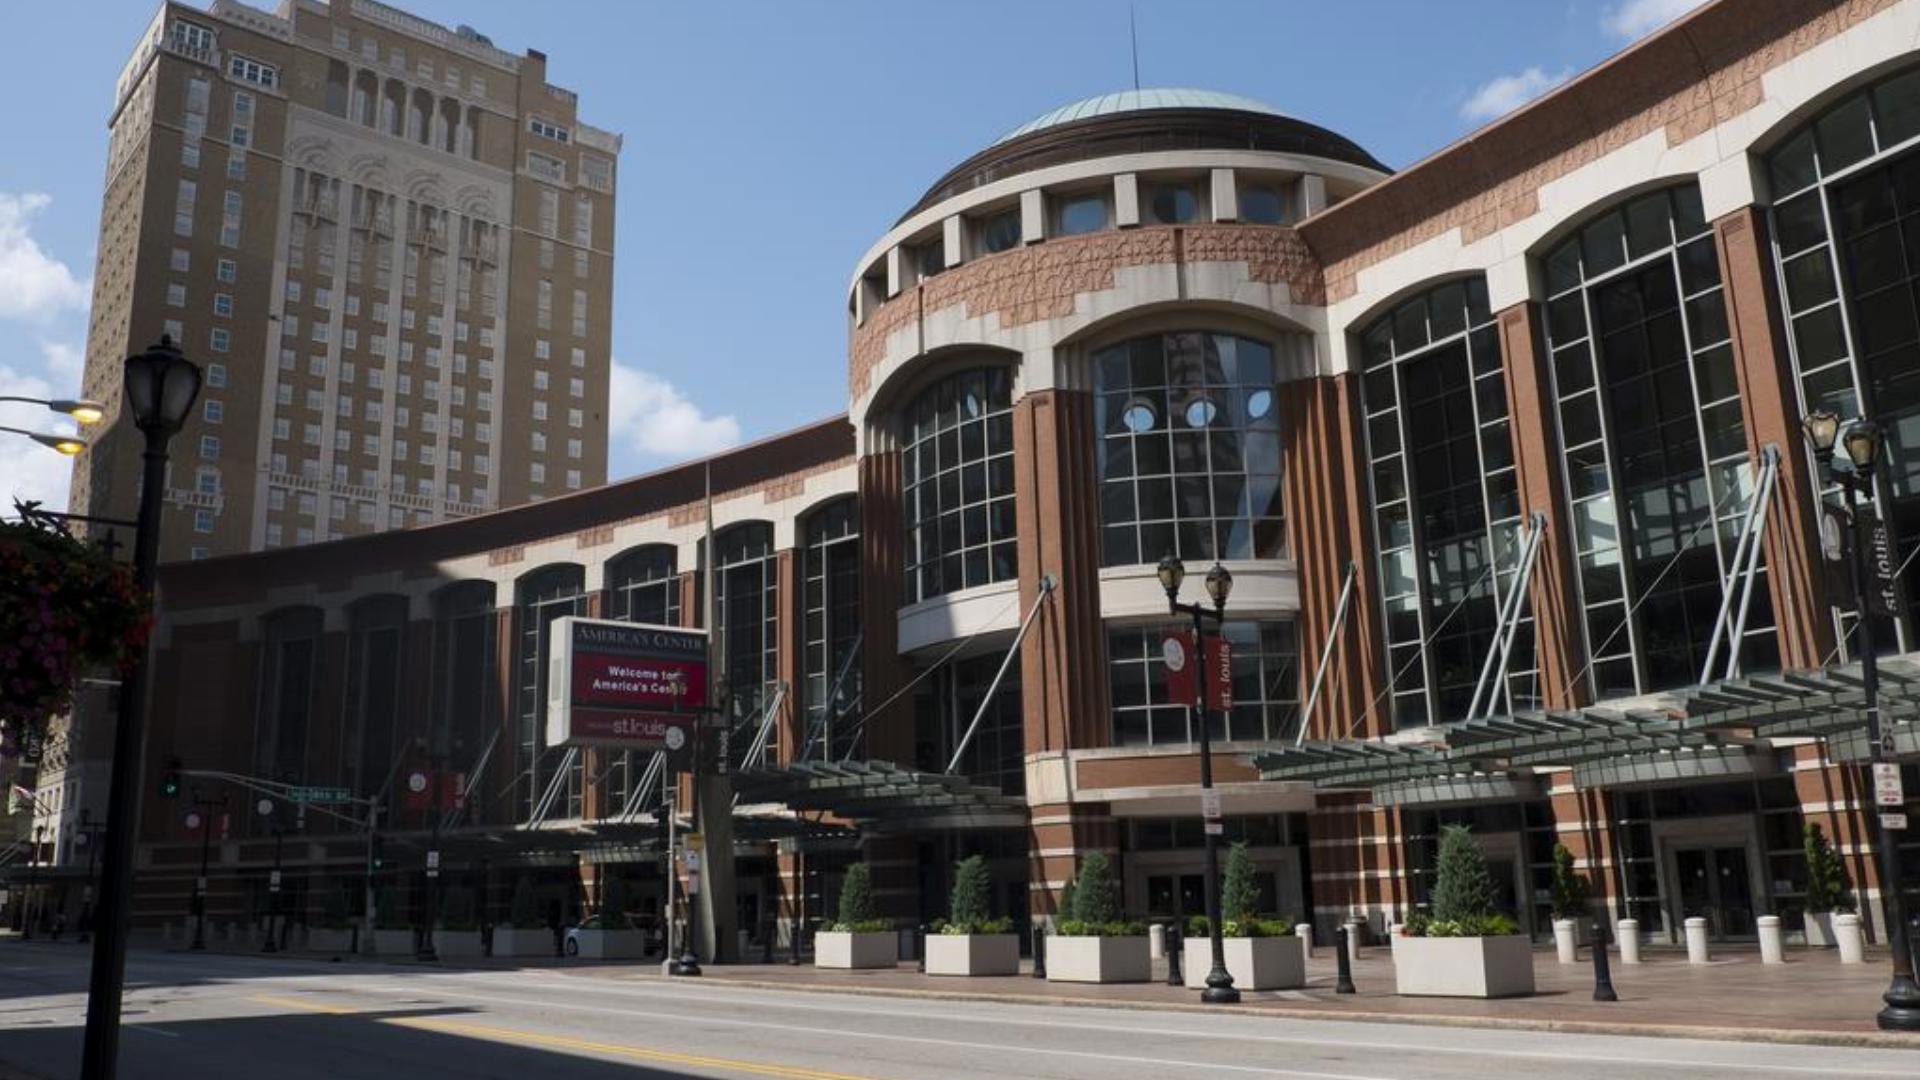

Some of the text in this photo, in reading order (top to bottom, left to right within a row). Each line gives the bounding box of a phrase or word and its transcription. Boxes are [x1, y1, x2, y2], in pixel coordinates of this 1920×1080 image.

[1872, 527, 1891, 579] louis
[608, 666, 658, 680] Welcome
[1219, 644, 1231, 683] louis
[593, 679, 648, 692] America's
